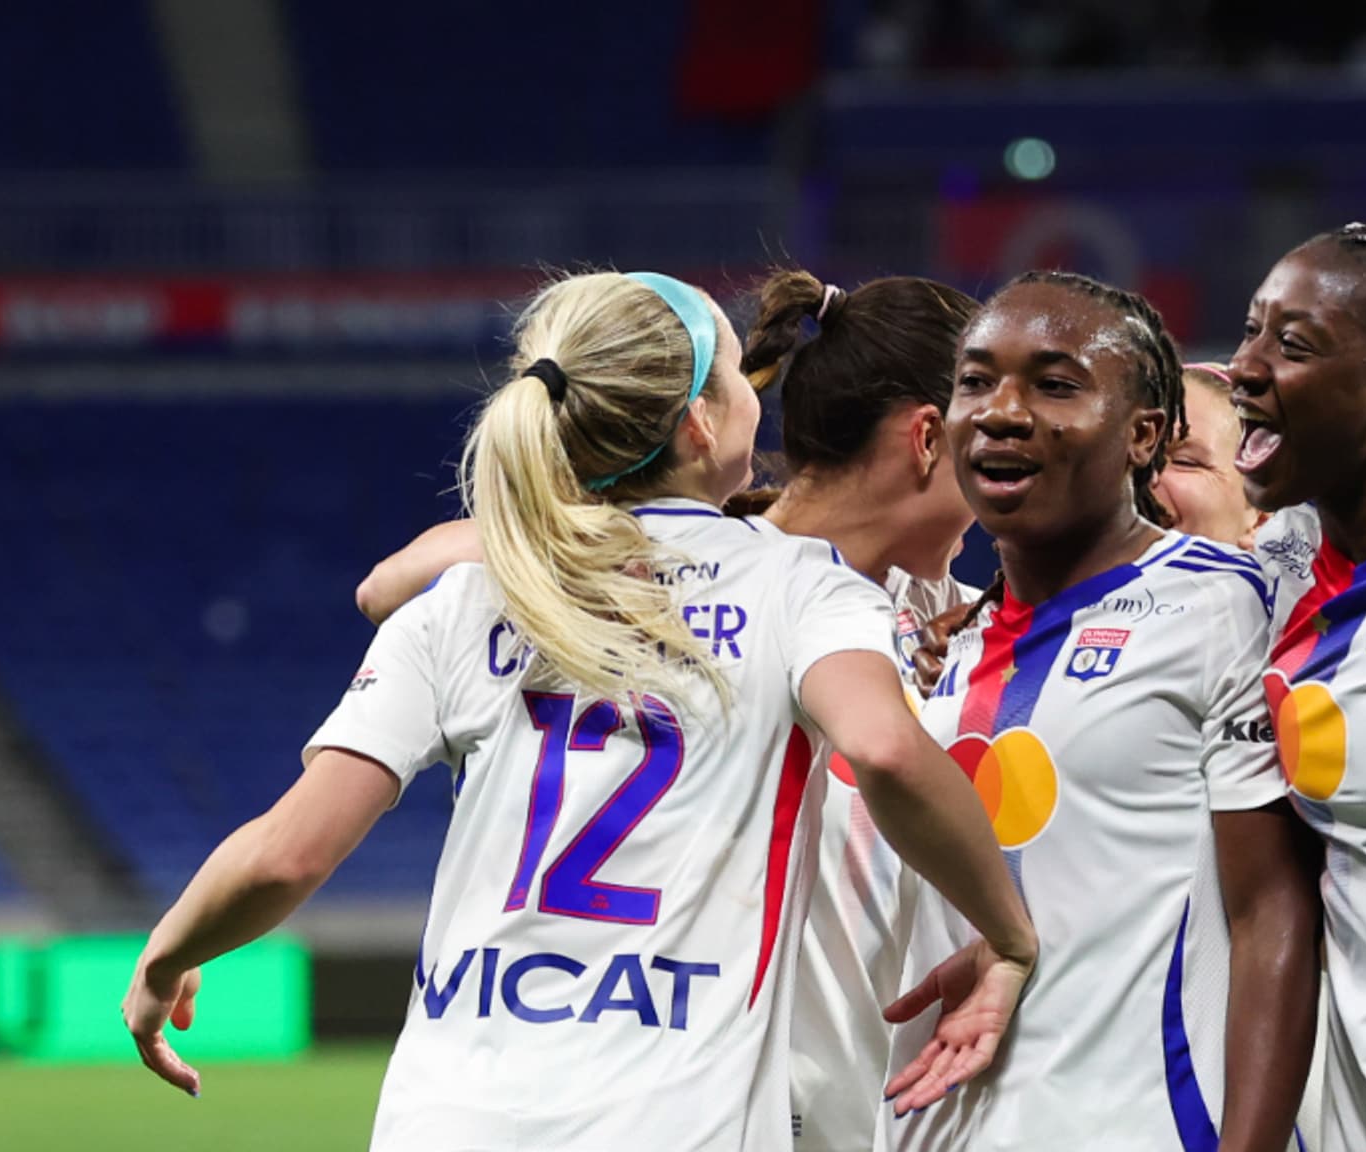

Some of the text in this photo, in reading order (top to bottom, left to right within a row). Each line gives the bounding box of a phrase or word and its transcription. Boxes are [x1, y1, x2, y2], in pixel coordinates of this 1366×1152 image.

[1072, 648, 1112, 673] OL
[1222, 719, 1276, 744] Kle
[502, 688, 685, 926] 12
[422, 947, 721, 1031] VICAT
